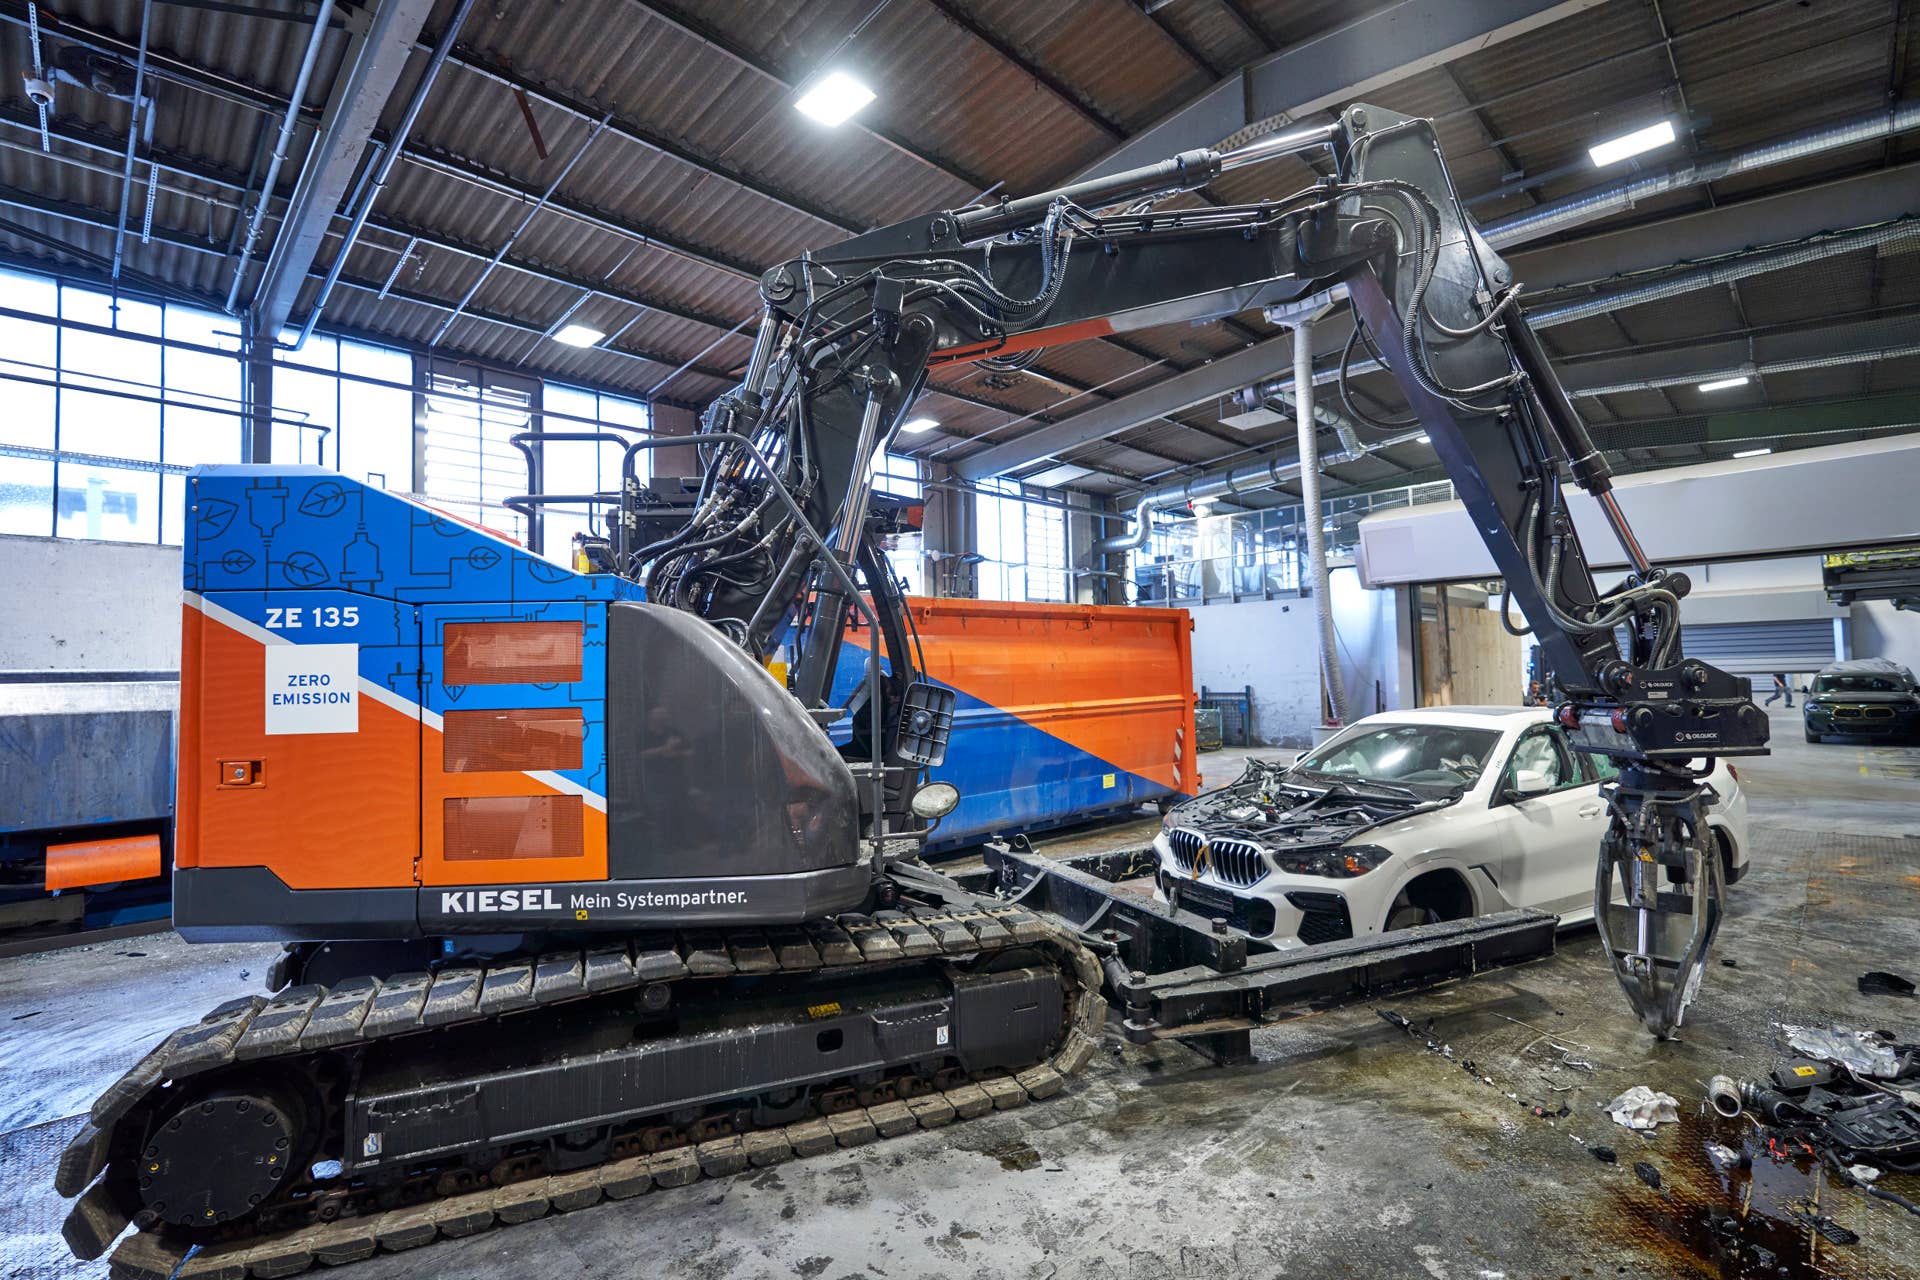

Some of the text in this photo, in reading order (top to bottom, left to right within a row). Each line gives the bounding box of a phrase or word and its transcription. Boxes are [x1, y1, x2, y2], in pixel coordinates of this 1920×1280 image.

[265, 607, 359, 628] ZE 135
[288, 674, 331, 687] ZERO
[273, 692, 351, 705] EMISSION
[441, 889, 748, 913] KIESEL Mein Systempartner.
